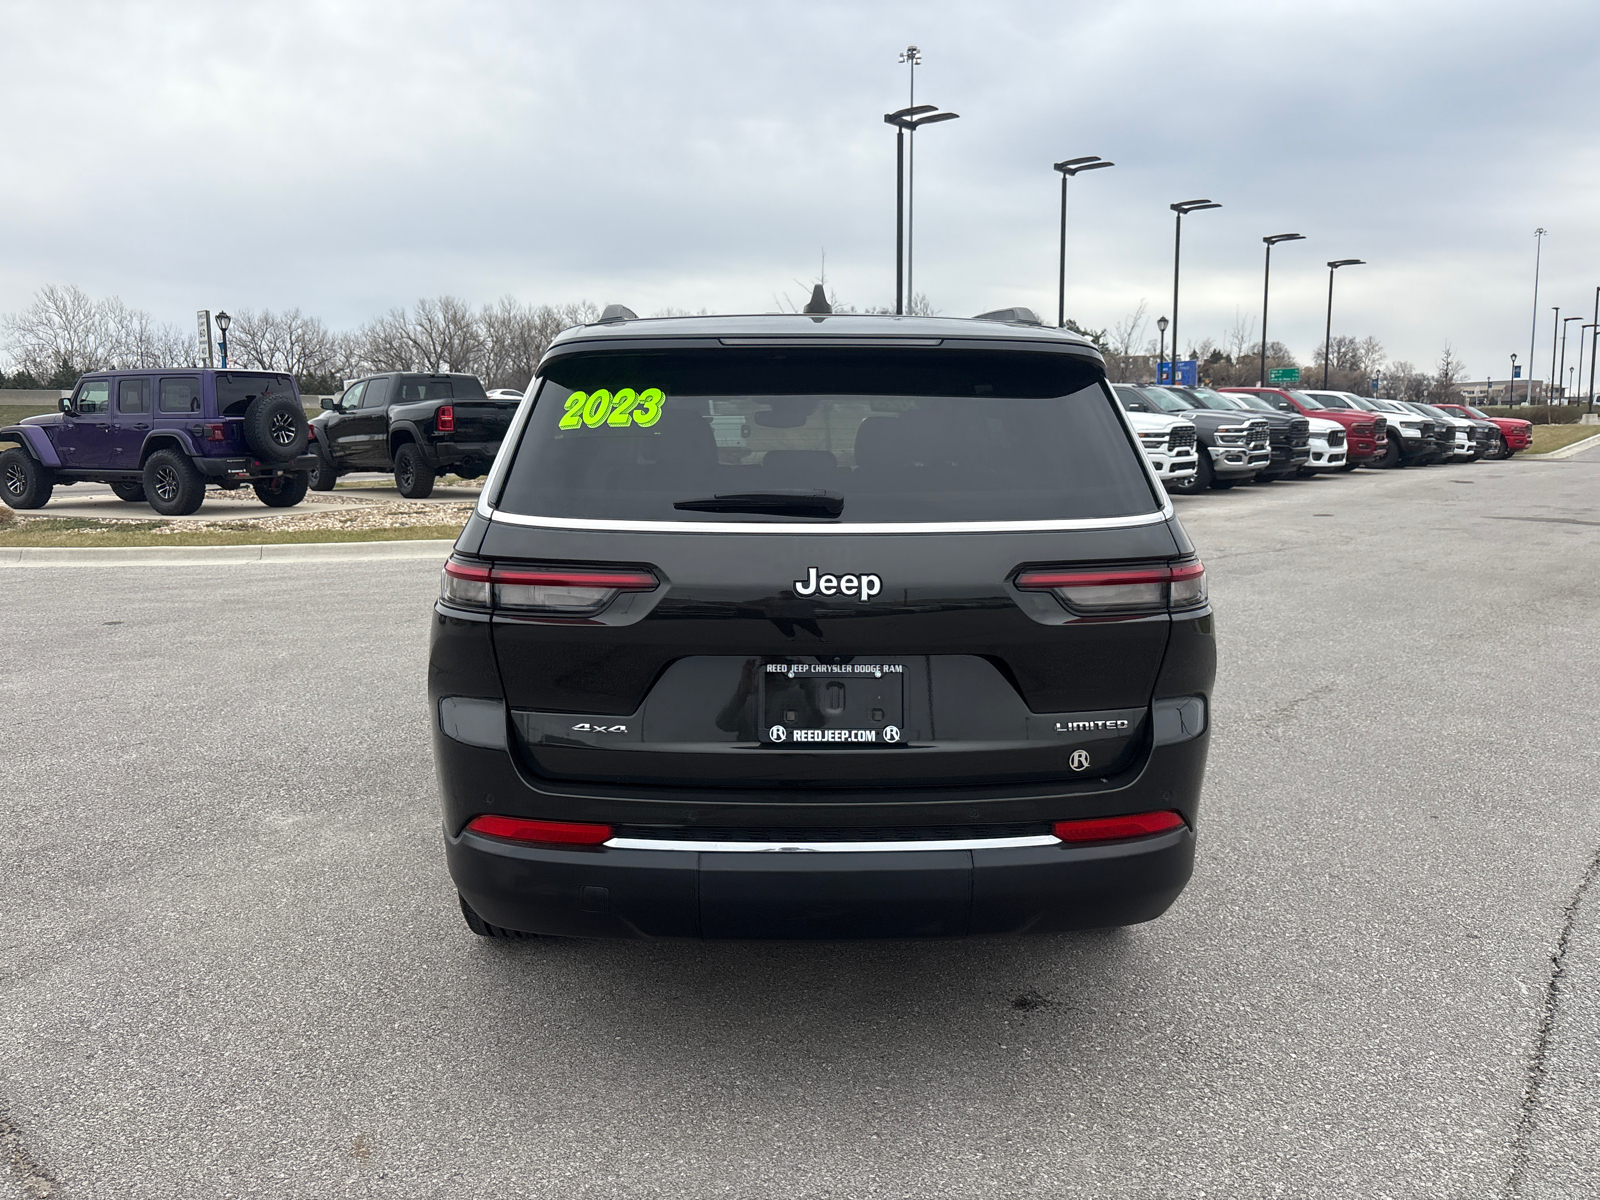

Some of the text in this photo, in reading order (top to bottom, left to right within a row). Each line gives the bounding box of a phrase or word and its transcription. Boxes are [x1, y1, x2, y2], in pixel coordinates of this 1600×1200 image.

[558, 387, 666, 430] 2023
[795, 567, 881, 601] Jeep
[766, 664, 903, 673] REED JEEP CHRYSLER DODGE RAM
[571, 723, 628, 734] 4x4
[770, 725, 901, 742] R REEDJEEP.COM R
[1055, 719, 1129, 732] LIMITED
[1070, 750, 1091, 770] R
